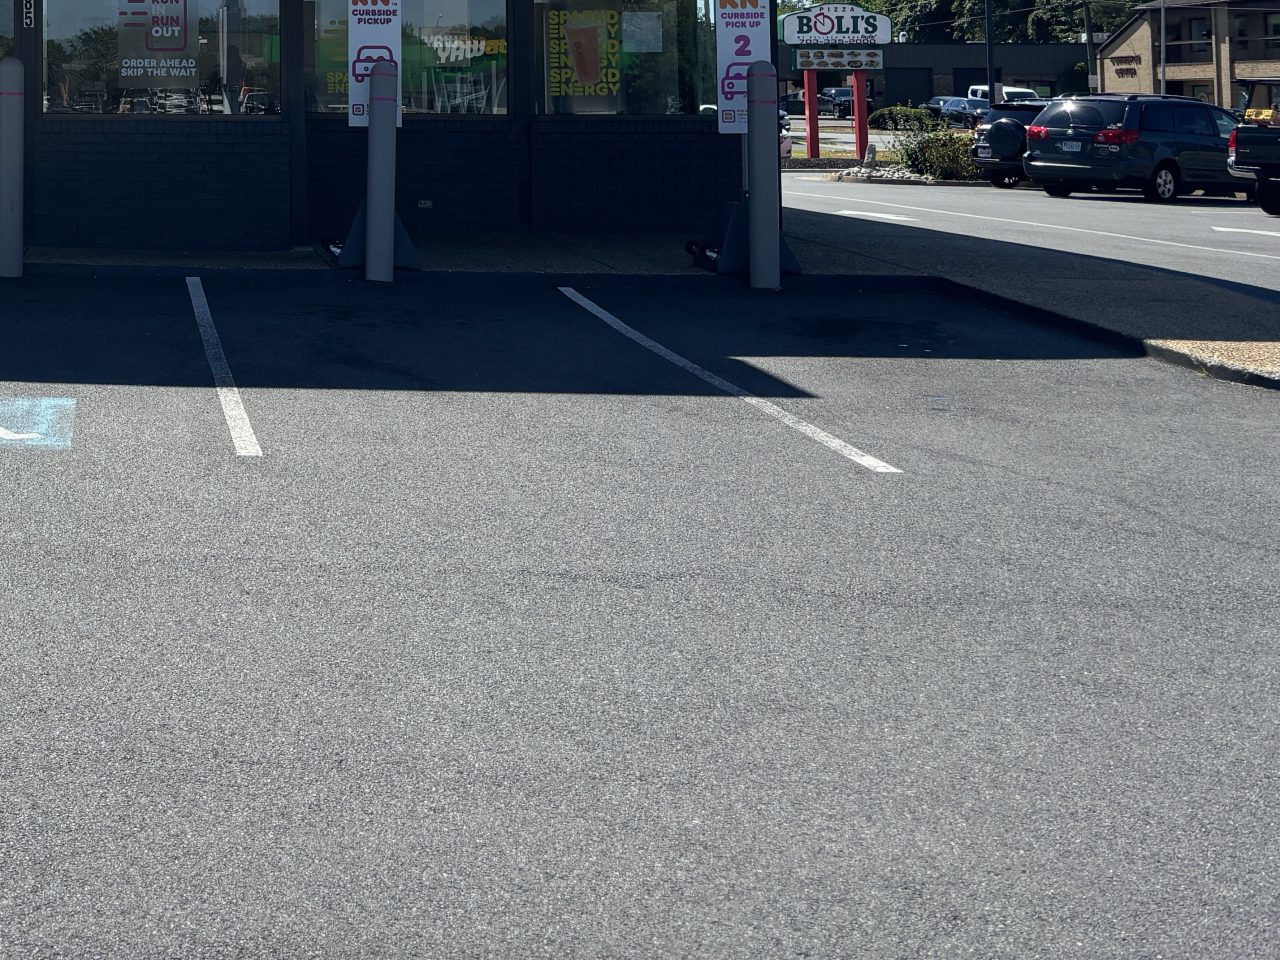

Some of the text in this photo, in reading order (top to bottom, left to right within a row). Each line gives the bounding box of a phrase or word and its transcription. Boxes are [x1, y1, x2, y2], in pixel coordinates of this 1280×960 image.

[152, 4, 166, 15] IN
[351, 8, 399, 17] CURBSIDE
[720, 12, 765, 20] CURBSIDE
[152, 16, 179, 26] RUN
[357, 17, 393, 26] PICKUP
[725, 21, 761, 29] PICK UP
[797, 12, 878, 35] BOLI'S
[152, 27, 181, 37] OUT
[733, 34, 753, 57] 2
[122, 59, 196, 67] ORDER AHEAD
[121, 68, 197, 77] SKIP THE WAIT
[549, 83, 622, 97] ENERGY
